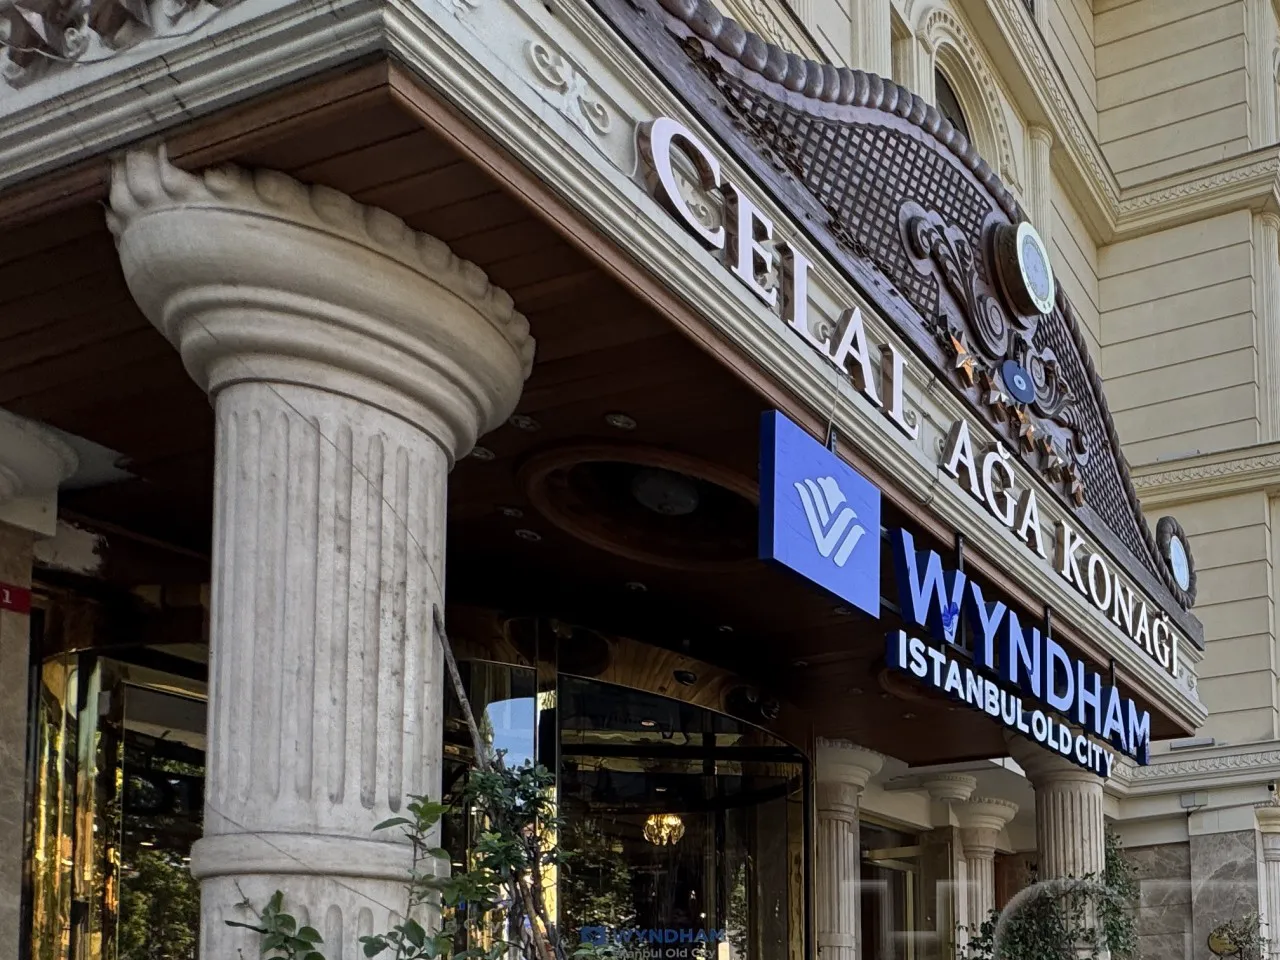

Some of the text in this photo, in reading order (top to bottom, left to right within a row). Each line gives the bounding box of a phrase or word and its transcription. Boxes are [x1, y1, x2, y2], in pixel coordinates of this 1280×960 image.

[651, 116, 1179, 678] CELAL AĞA KONAĞI
[898, 629, 1117, 778] ISTANBUL OLD CITY
[899, 527, 1151, 766] WYNDHAM
[612, 927, 726, 944] WYNDHAM
[665, 948, 688, 958] Old
[691, 948, 716, 960] City
